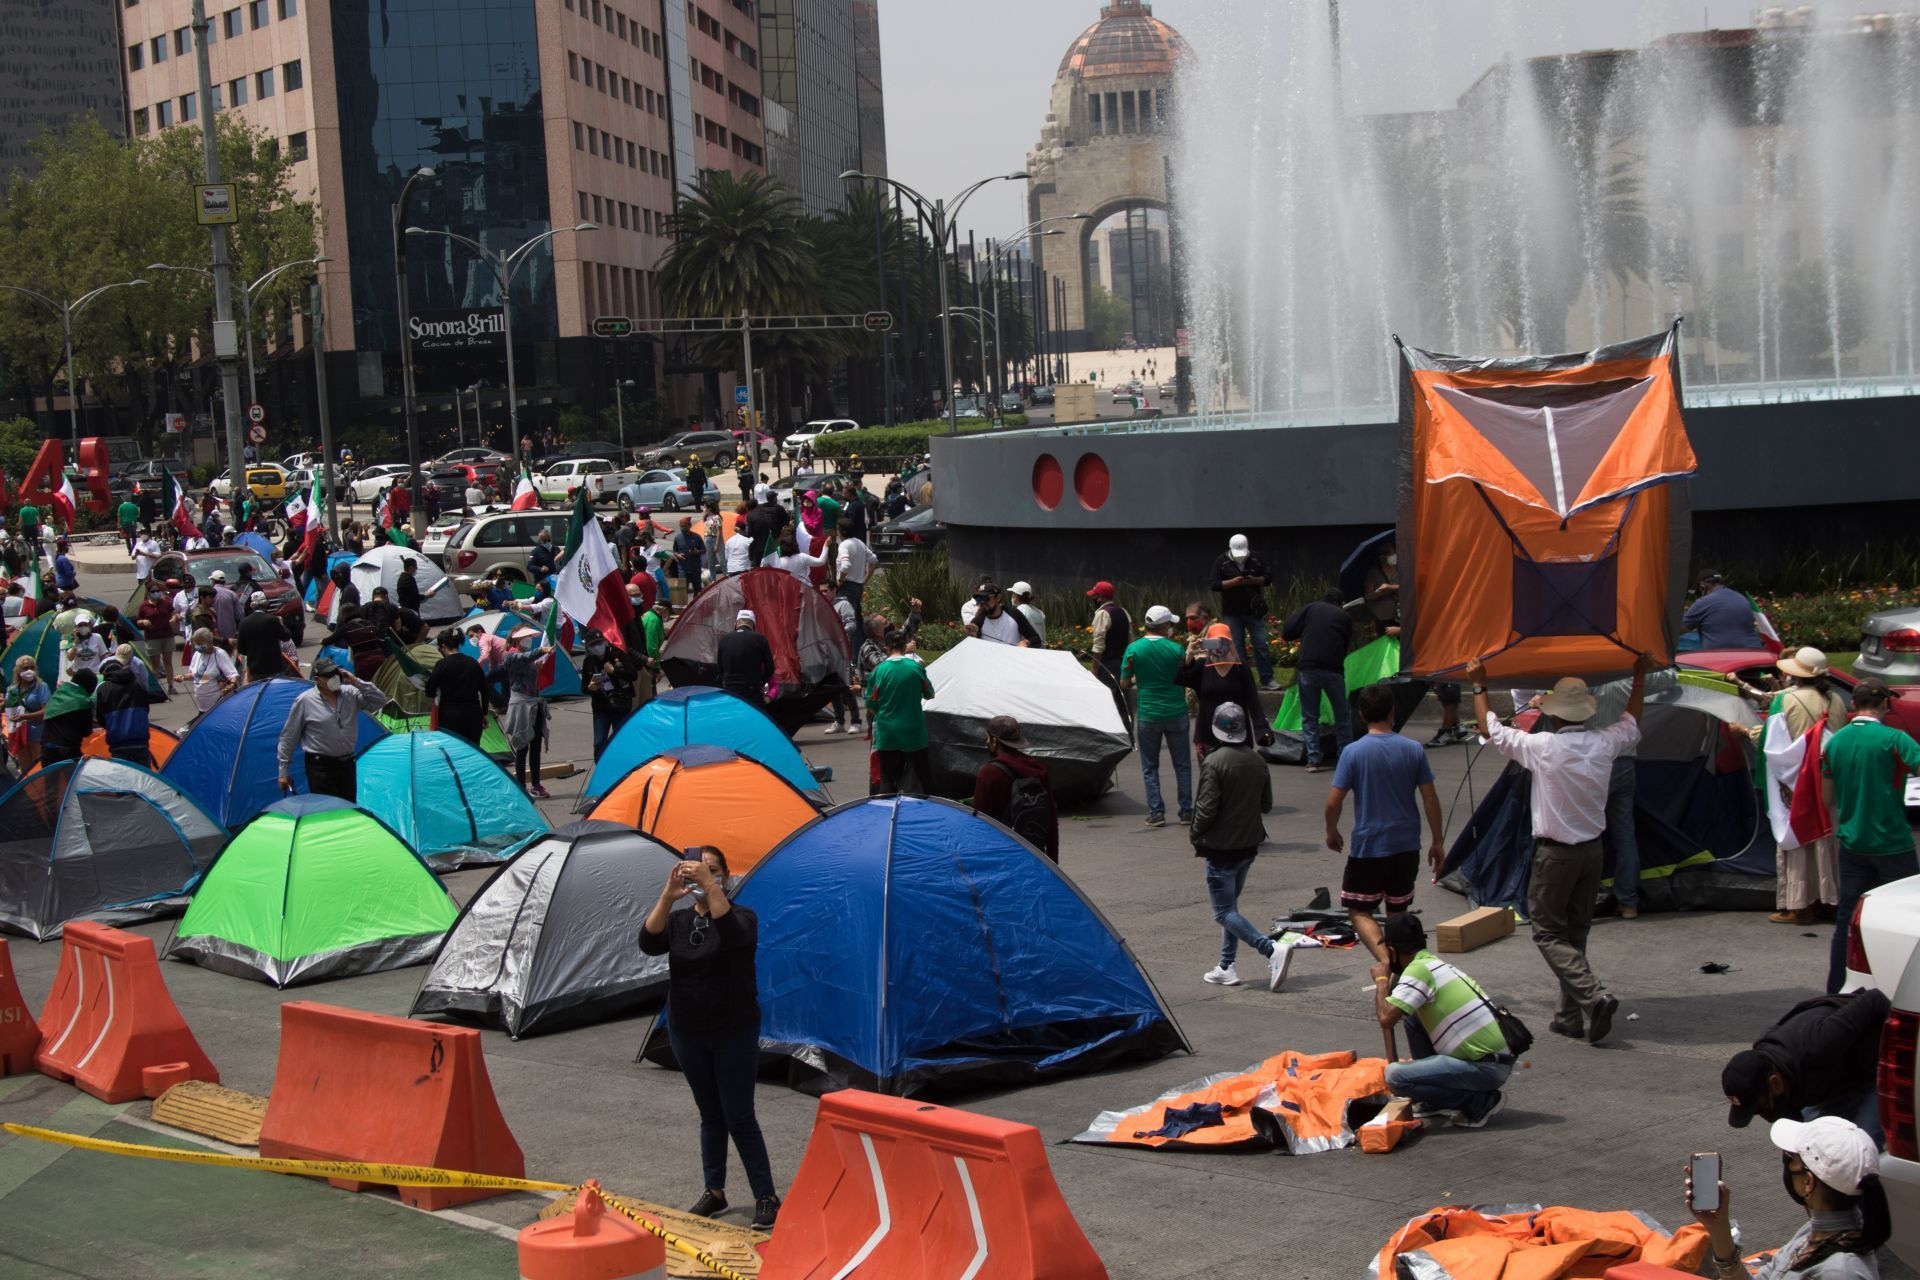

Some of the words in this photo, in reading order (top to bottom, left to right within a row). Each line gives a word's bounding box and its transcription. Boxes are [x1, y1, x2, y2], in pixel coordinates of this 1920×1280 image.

[409, 316, 467, 339] Sonora
[422, 340, 451, 348] Cocina
[467, 337, 493, 346] Brasa
